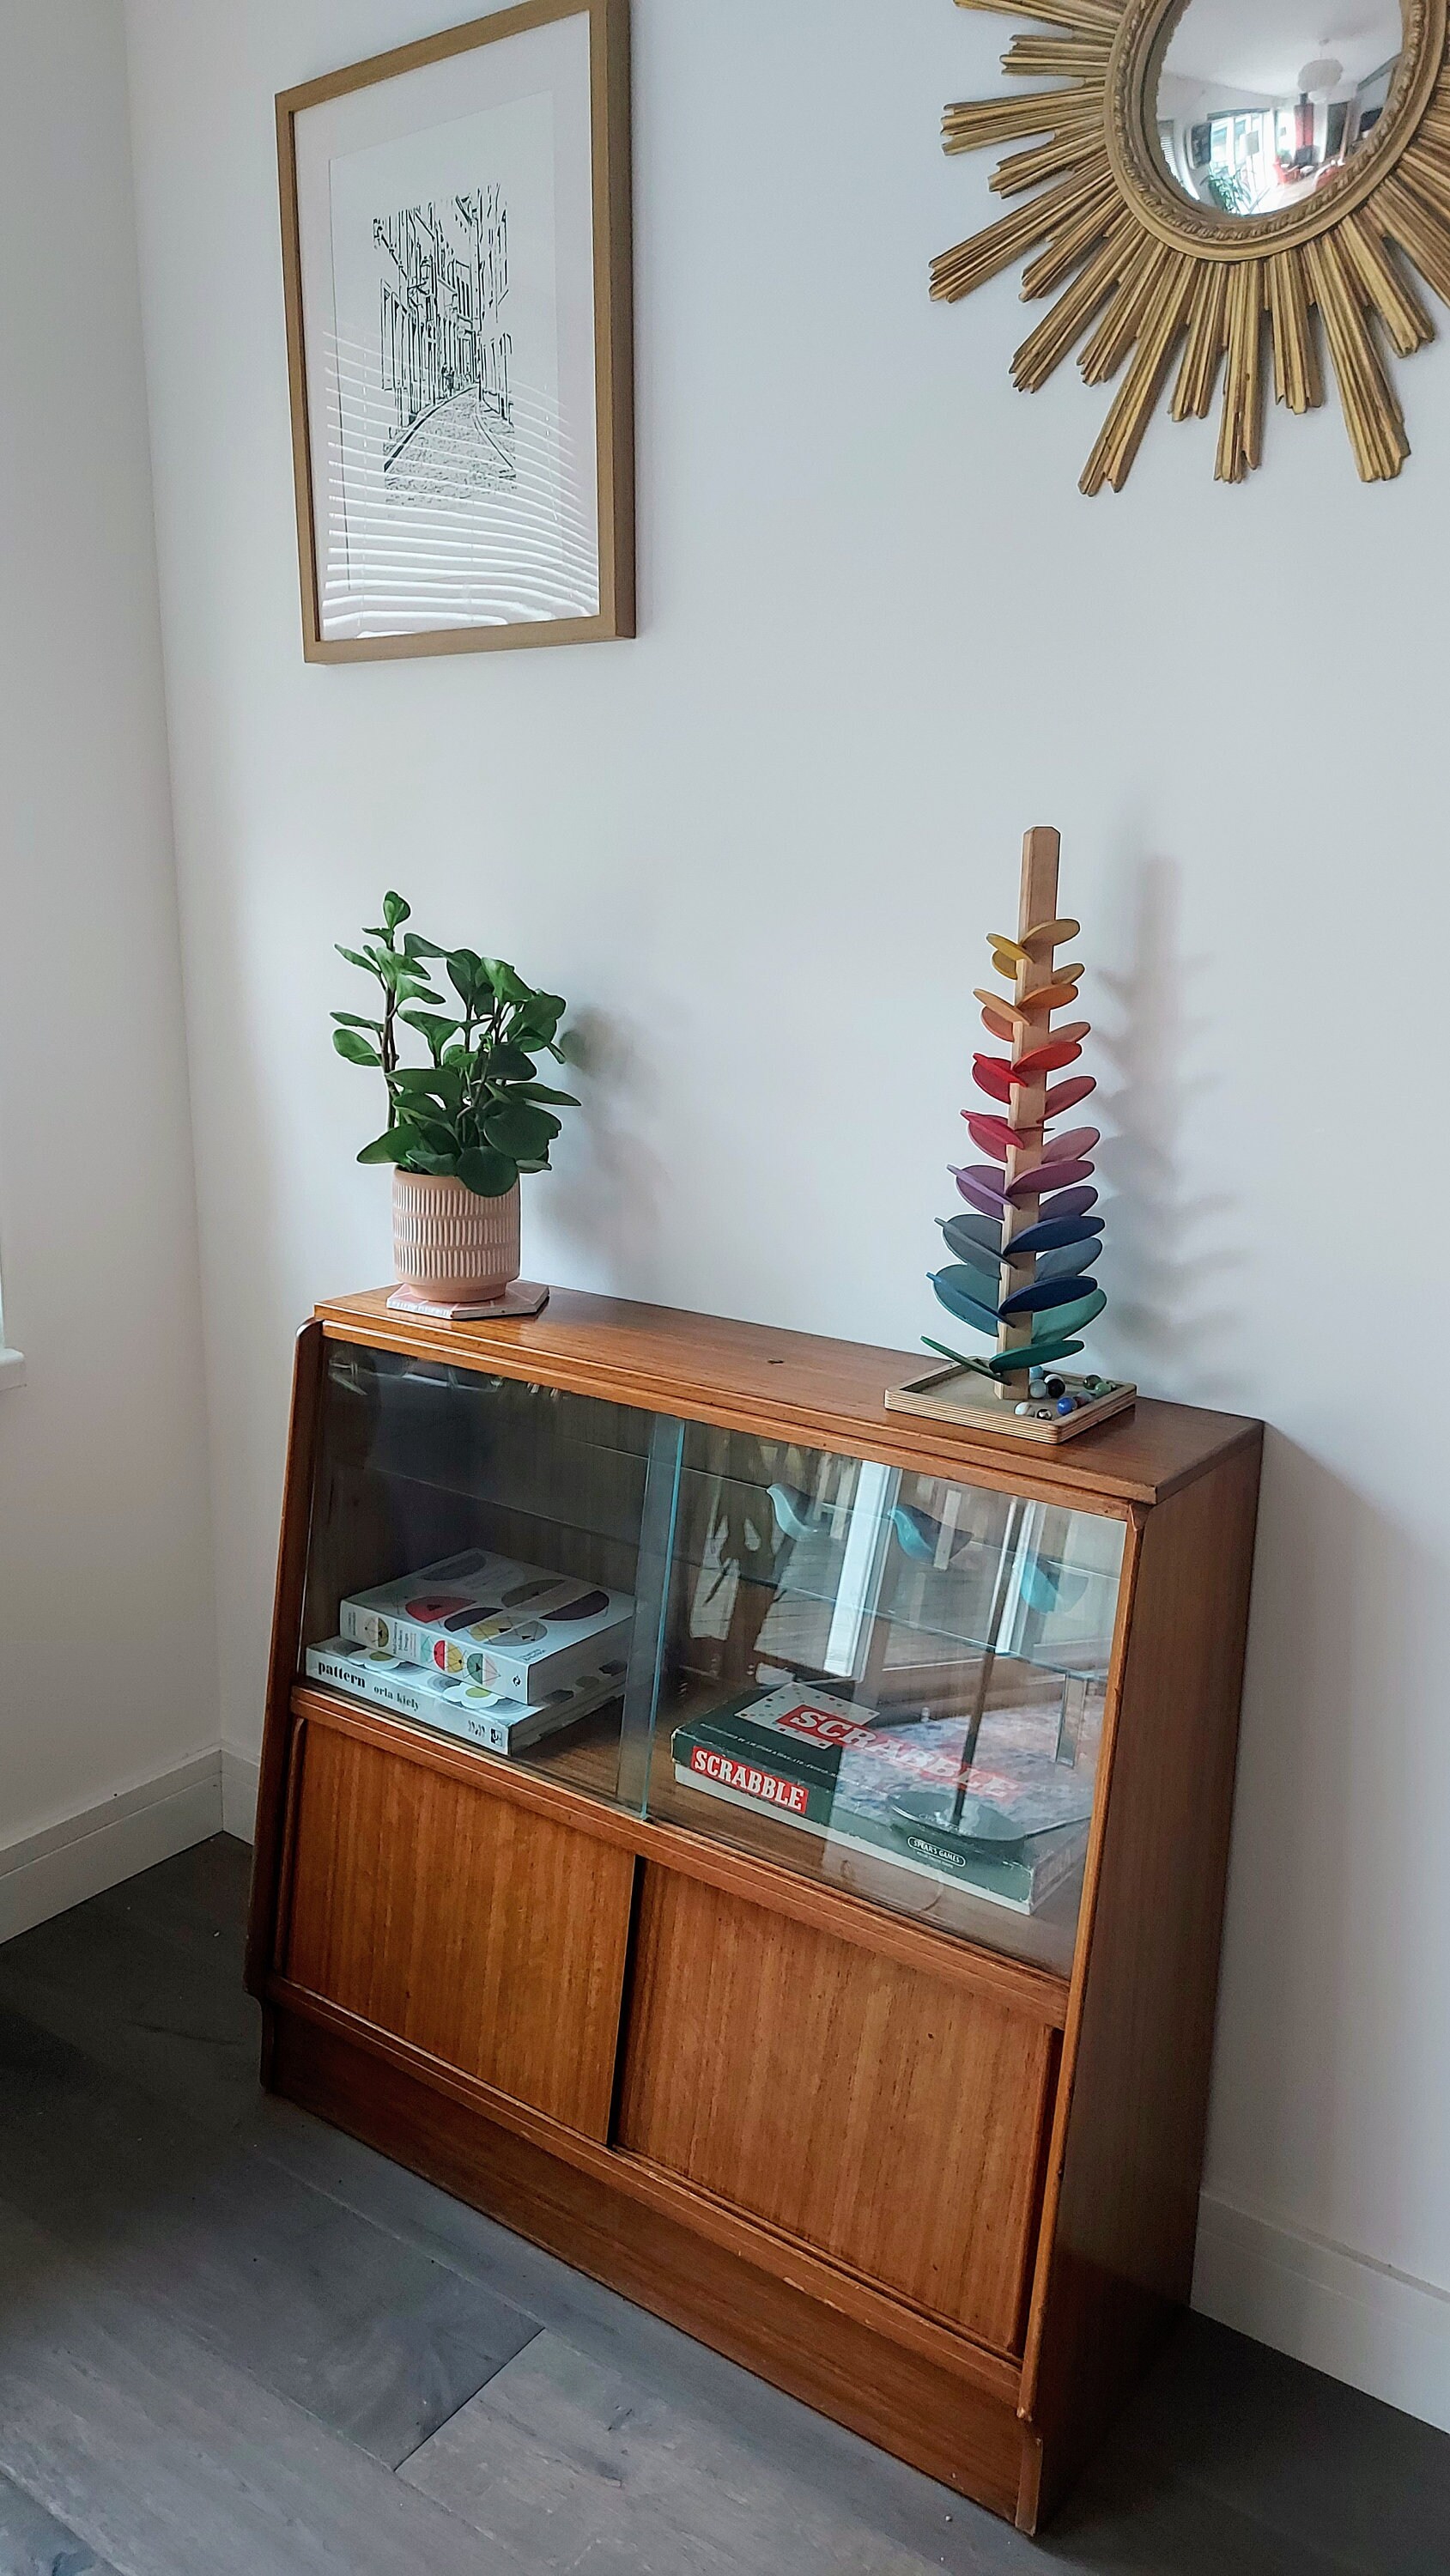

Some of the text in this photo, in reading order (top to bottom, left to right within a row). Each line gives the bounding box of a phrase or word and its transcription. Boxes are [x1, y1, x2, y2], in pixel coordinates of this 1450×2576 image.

[318, 1662, 366, 1688] pattern
[373, 1686, 420, 1711] orla kiely
[792, 1710, 1019, 1797] SCRABBLE
[695, 1750, 804, 1810] SCRABBLE
[938, 1850, 960, 1862] GAMES
